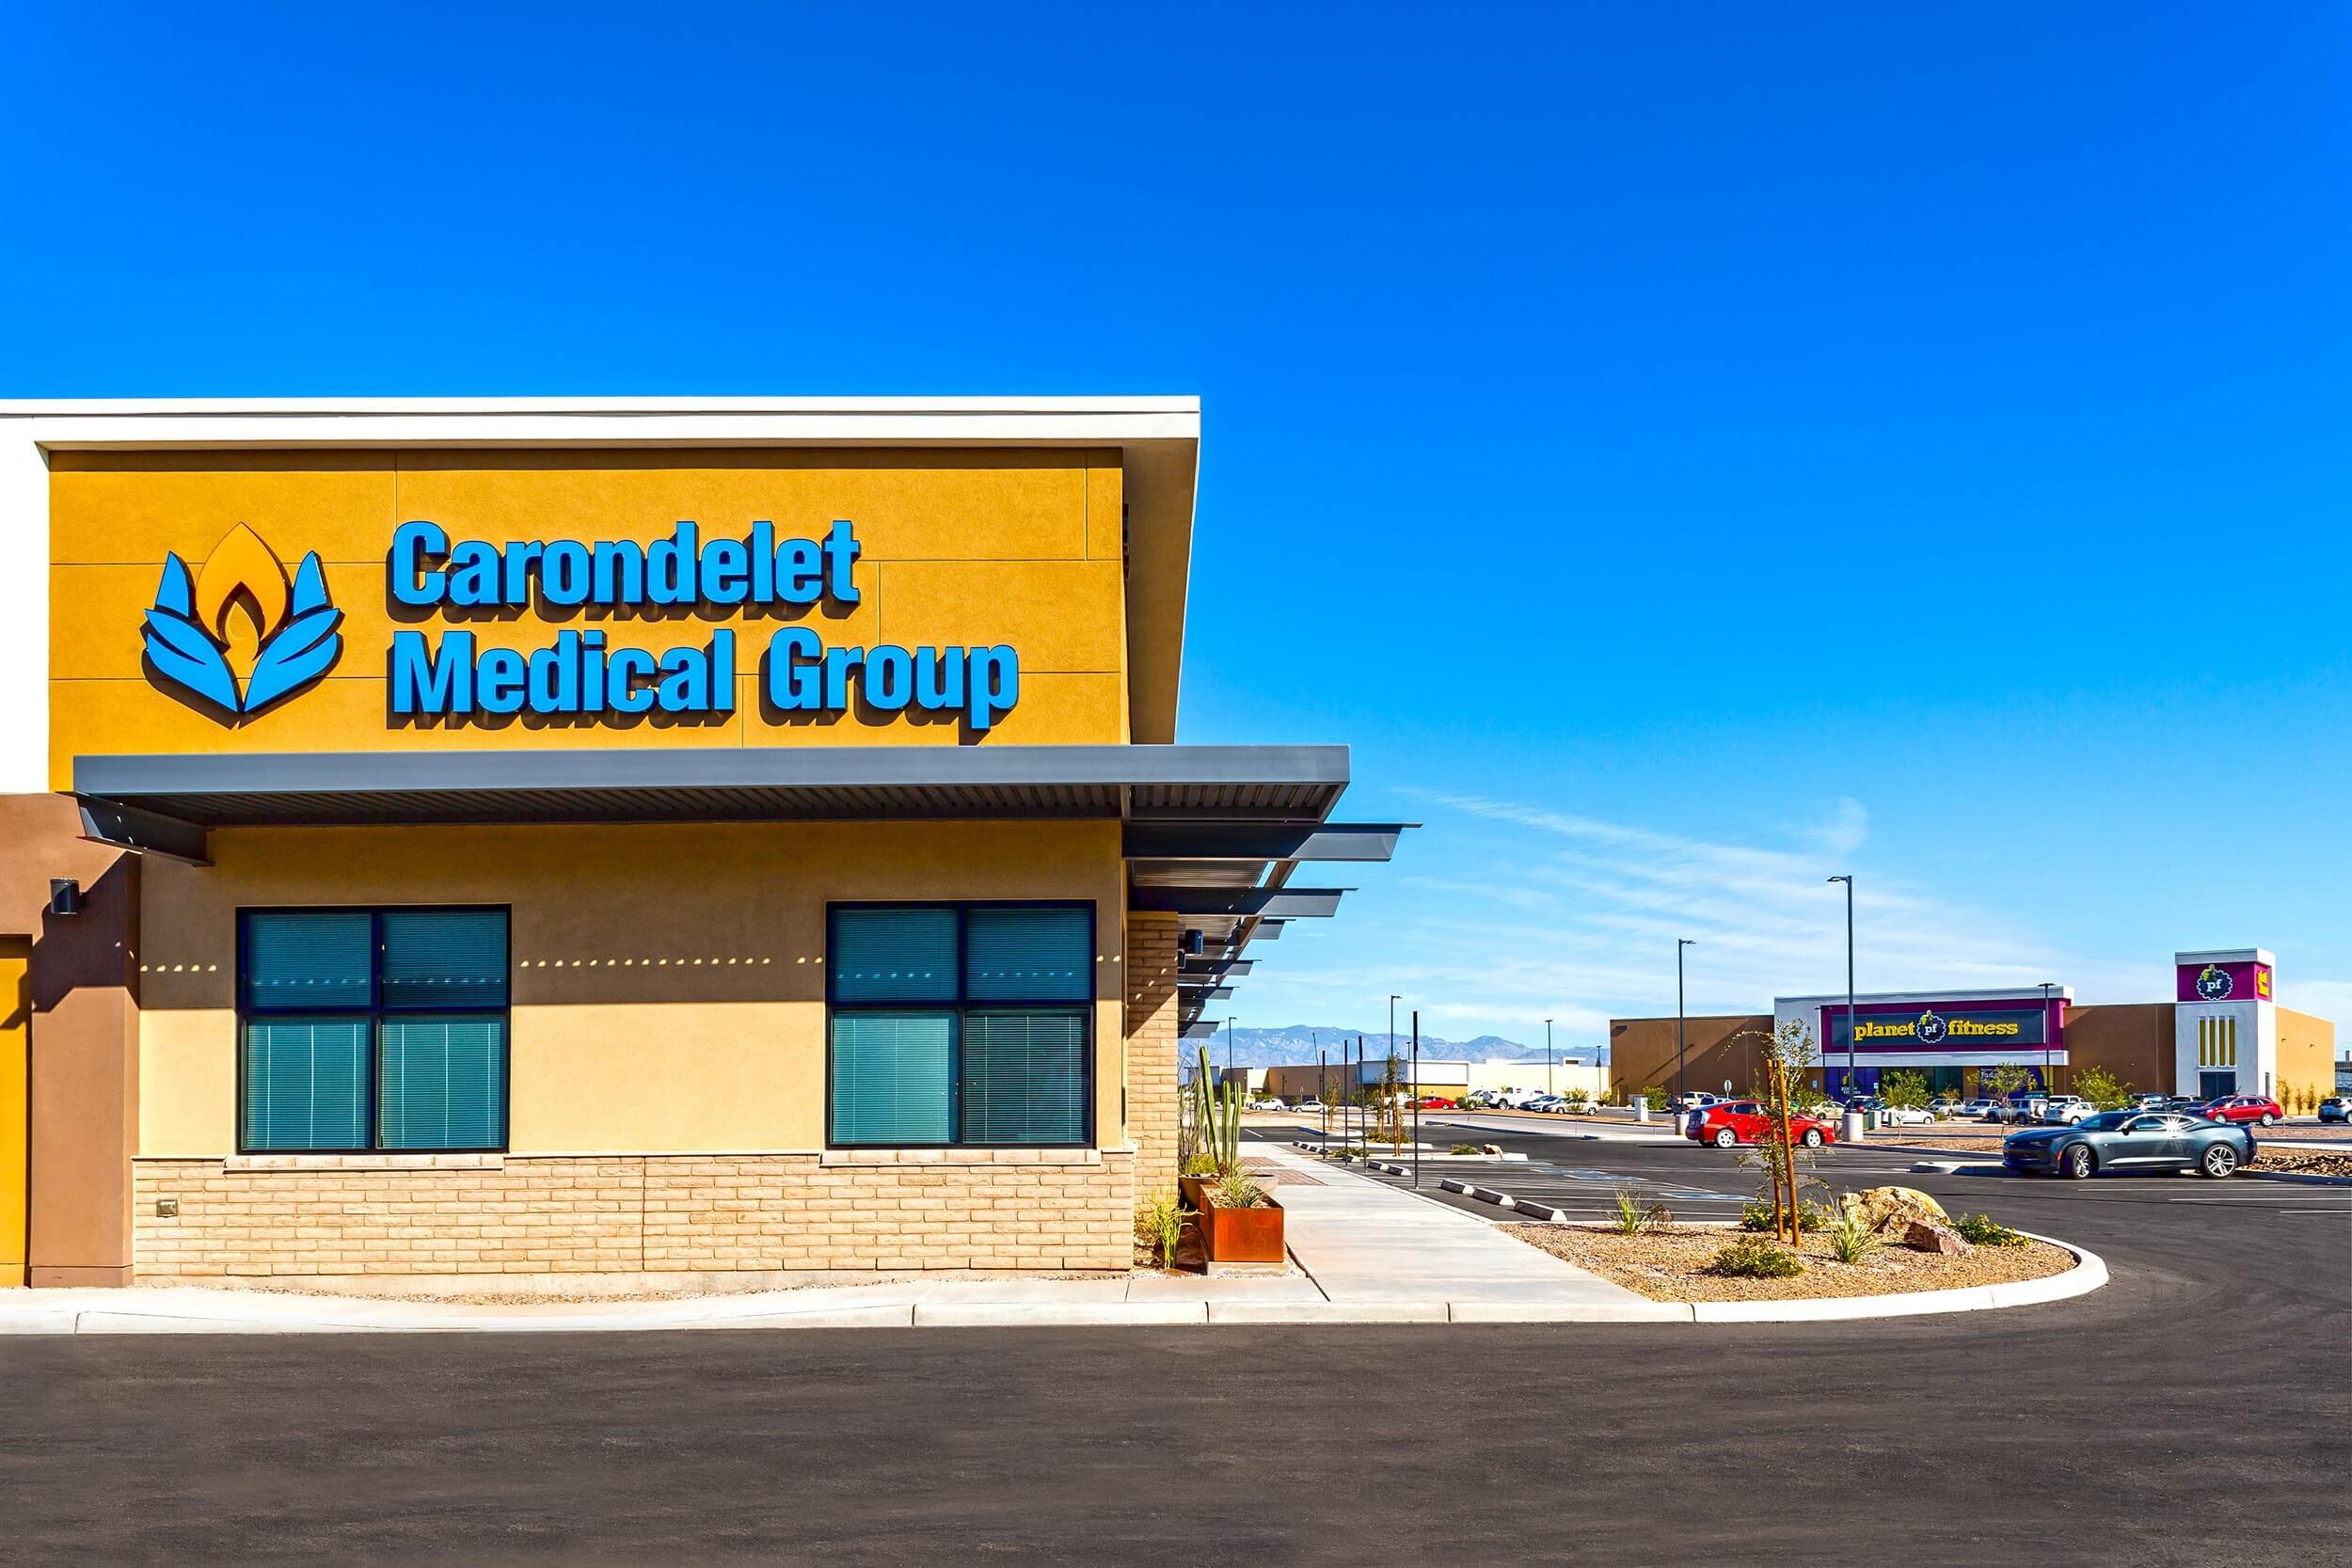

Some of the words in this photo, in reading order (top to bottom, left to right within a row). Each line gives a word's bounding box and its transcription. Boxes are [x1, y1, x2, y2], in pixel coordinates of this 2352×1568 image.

[392, 519, 860, 608] Carondelet
[392, 628, 736, 714] Medical
[769, 626, 1020, 730] Group
[2206, 978, 2222, 992] pf
[1854, 1022, 1915, 1041] planet
[1924, 1023, 1938, 1036] pf
[1947, 1020, 2018, 1036] fitness
